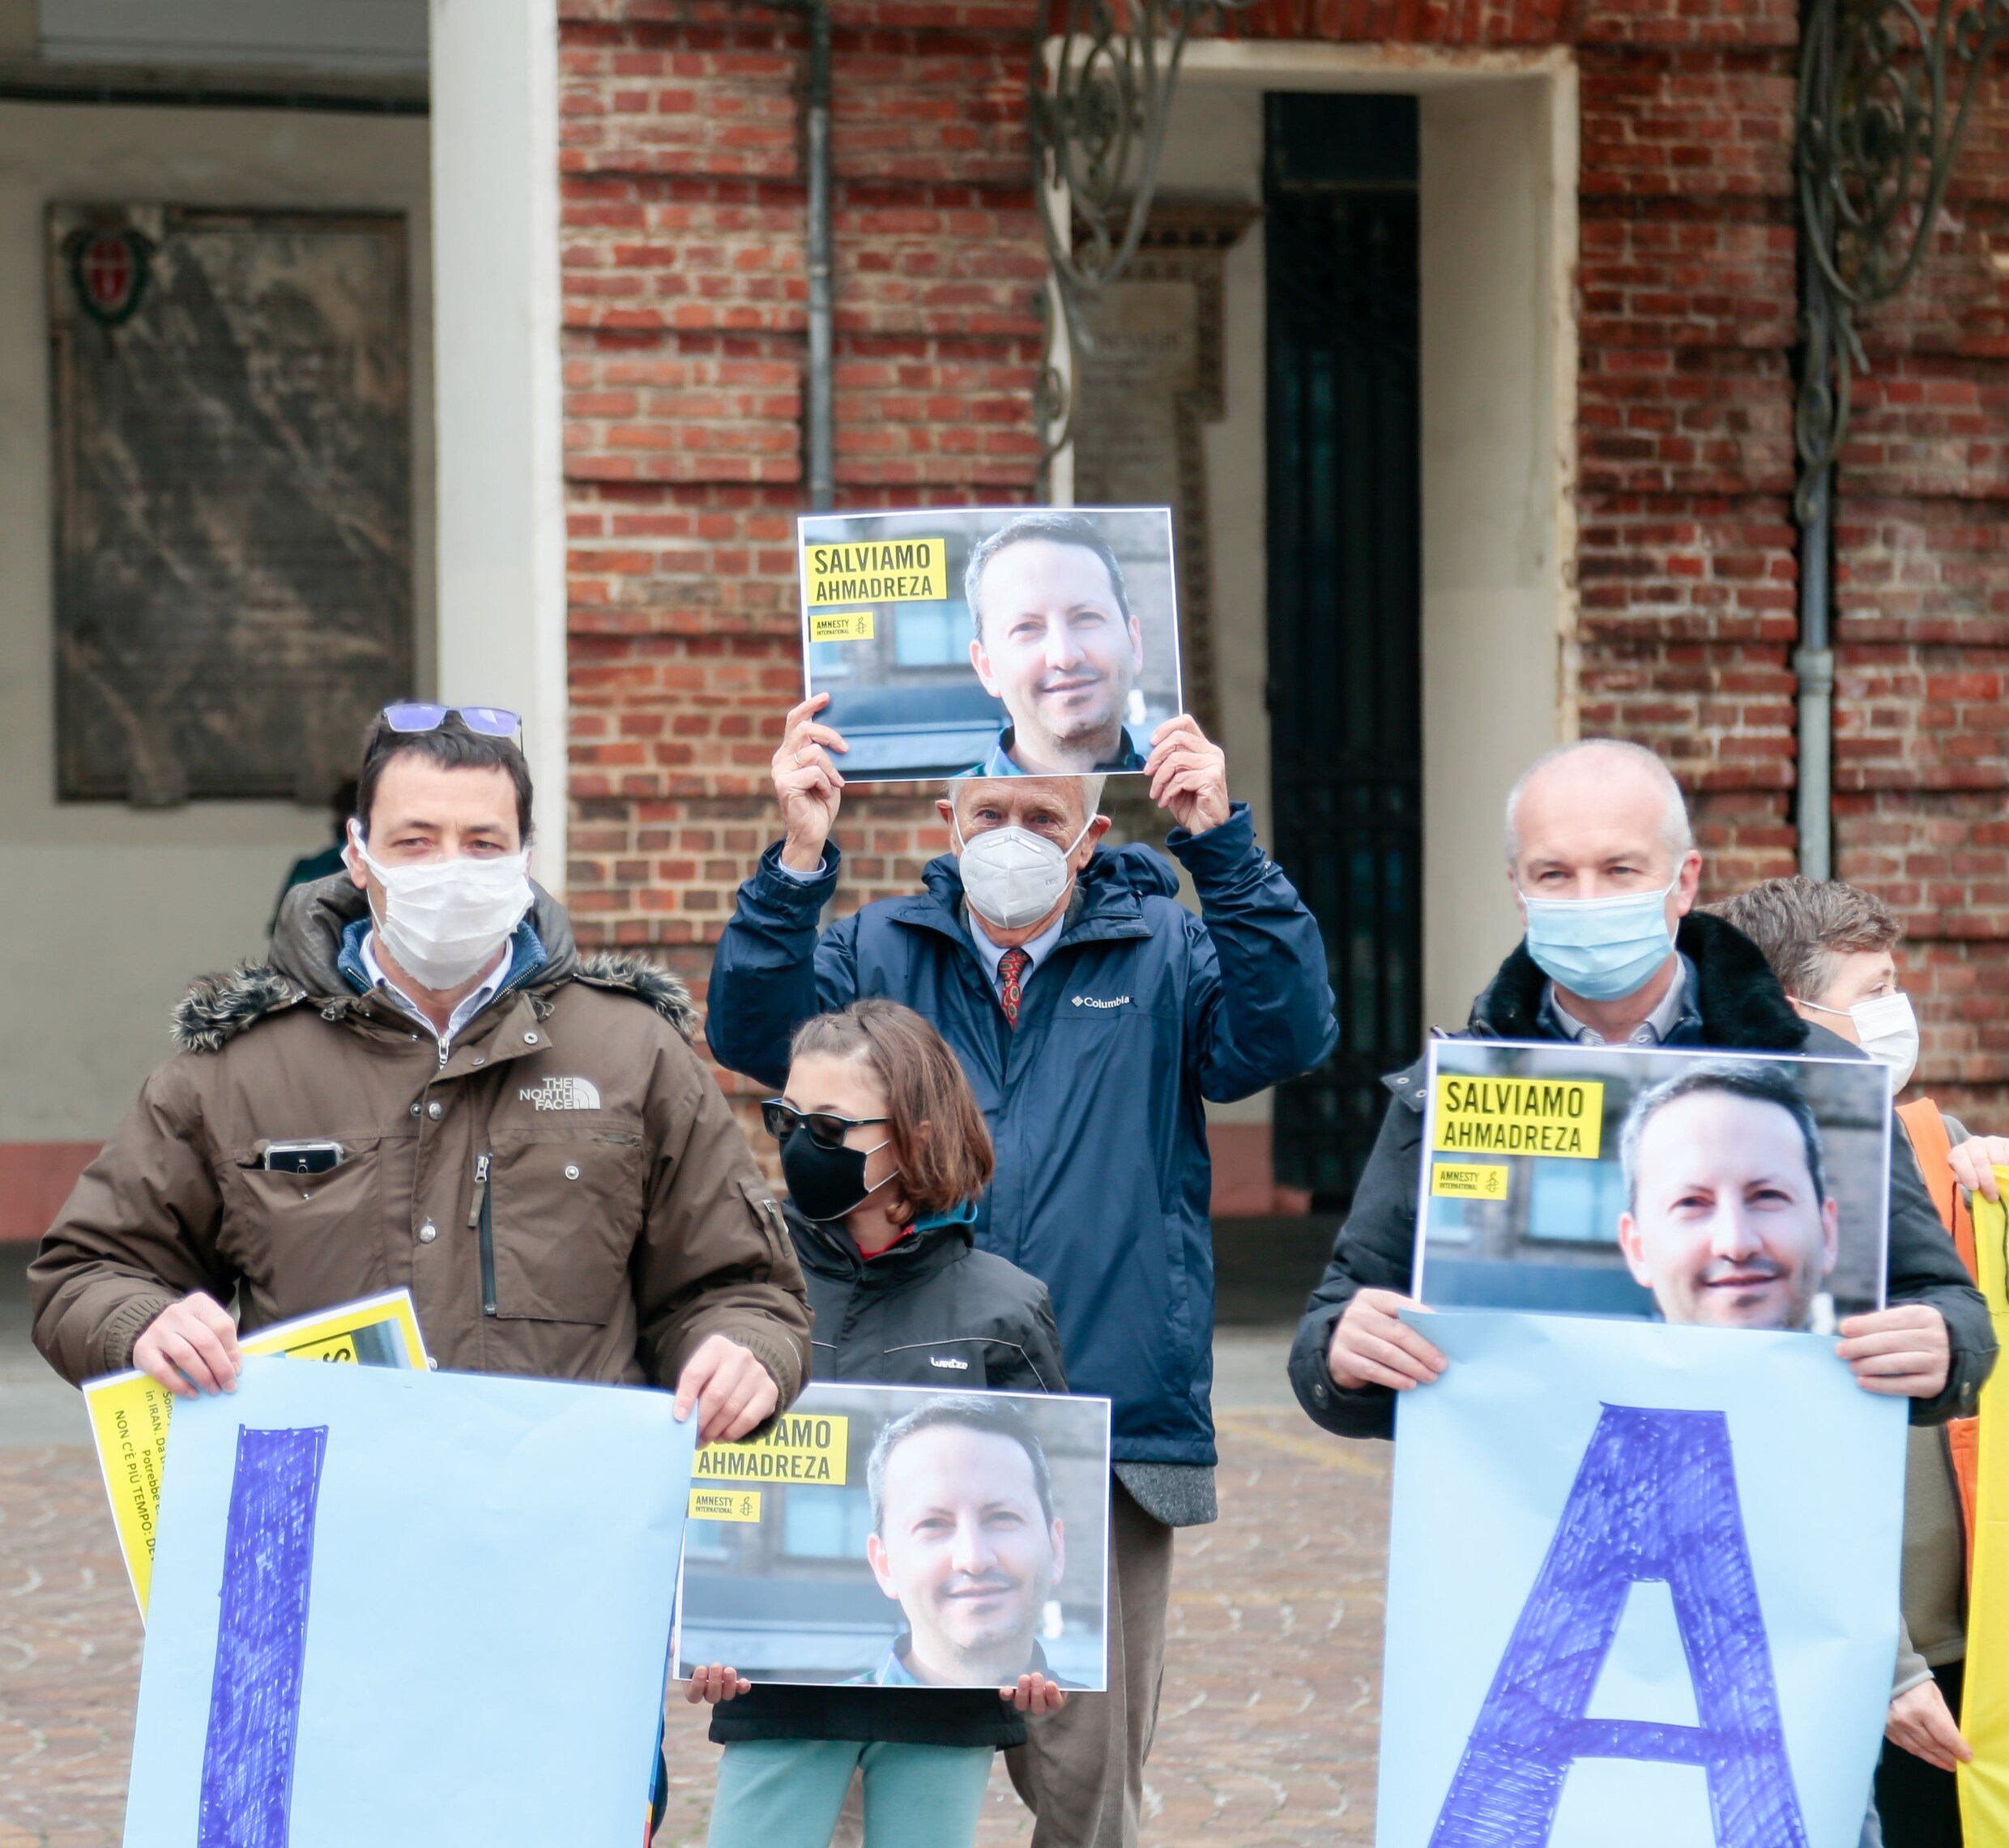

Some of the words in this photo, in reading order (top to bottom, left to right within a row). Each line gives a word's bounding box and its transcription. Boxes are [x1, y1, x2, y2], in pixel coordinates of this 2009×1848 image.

[814, 544, 931, 574] SALVIAMO
[816, 575, 932, 601] AHMADREZA
[817, 620, 849, 630] AMNESTY
[1084, 995, 1130, 1009] Columbia
[519, 1089, 573, 1100] NORTH
[542, 1078, 574, 1089] THE
[535, 1099, 574, 1111] FACE
[1445, 1082, 1585, 1118] SALVIAMO
[1444, 1121, 1582, 1153] AHMADREZA
[1440, 1171, 1480, 1183] AMNESTY
[145, 1389, 155, 1402] in
[115, 1410, 130, 1439] NON
[148, 1403, 162, 1436] IRAN.
[156, 1437, 165, 1453] Da
[127, 1462, 142, 1484] PIÙ
[142, 1449, 160, 1501] Potrebbe
[697, 1451, 831, 1479] AHMADREZA
[133, 1486, 152, 1536] TEMPO:
[696, 1496, 734, 1506] AMNESTY
[1428, 1401, 1810, 1848] A
